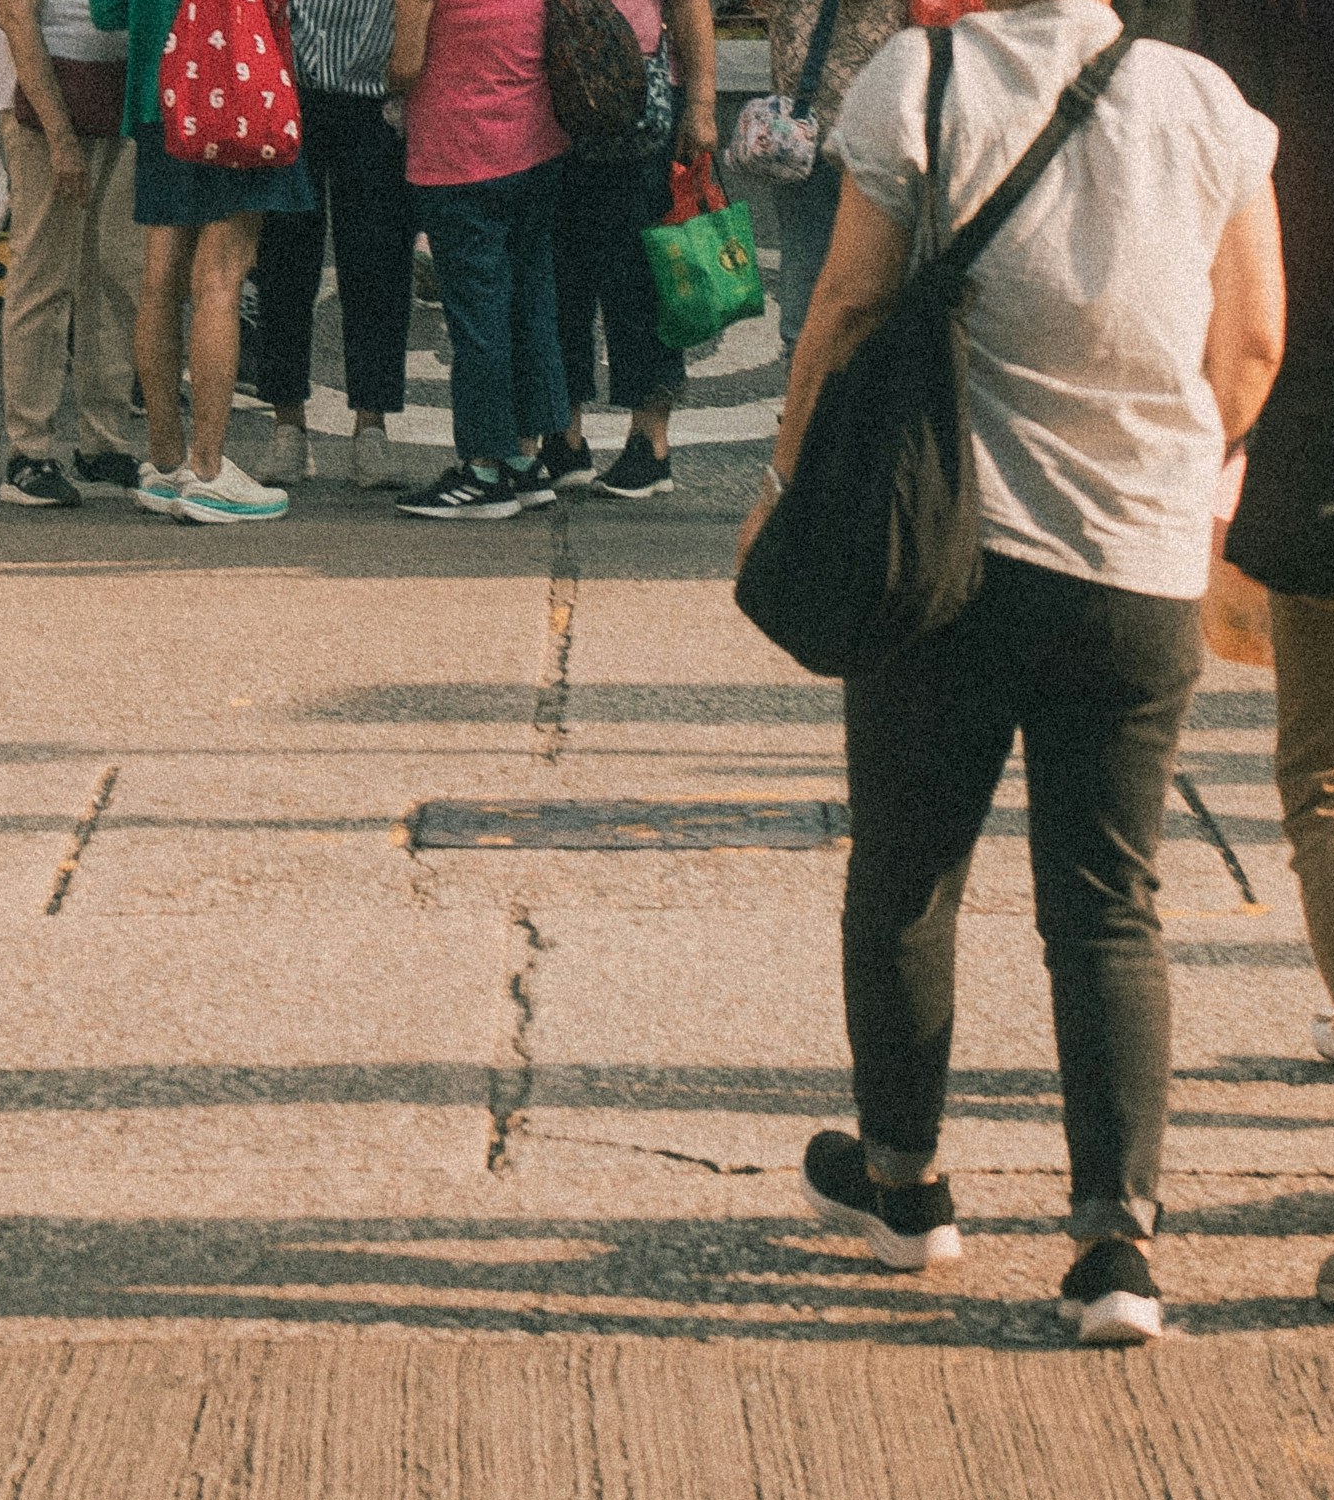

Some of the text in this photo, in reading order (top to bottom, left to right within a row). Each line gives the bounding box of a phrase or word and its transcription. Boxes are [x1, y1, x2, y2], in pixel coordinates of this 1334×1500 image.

[208, 29, 227, 50] 4
[185, 60, 199, 79] 2
[235, 62, 250, 82] 9
[209, 88, 225, 109] 6
[261, 91, 276, 109] 7
[183, 115, 198, 137] 5
[236, 116, 248, 138] 3
